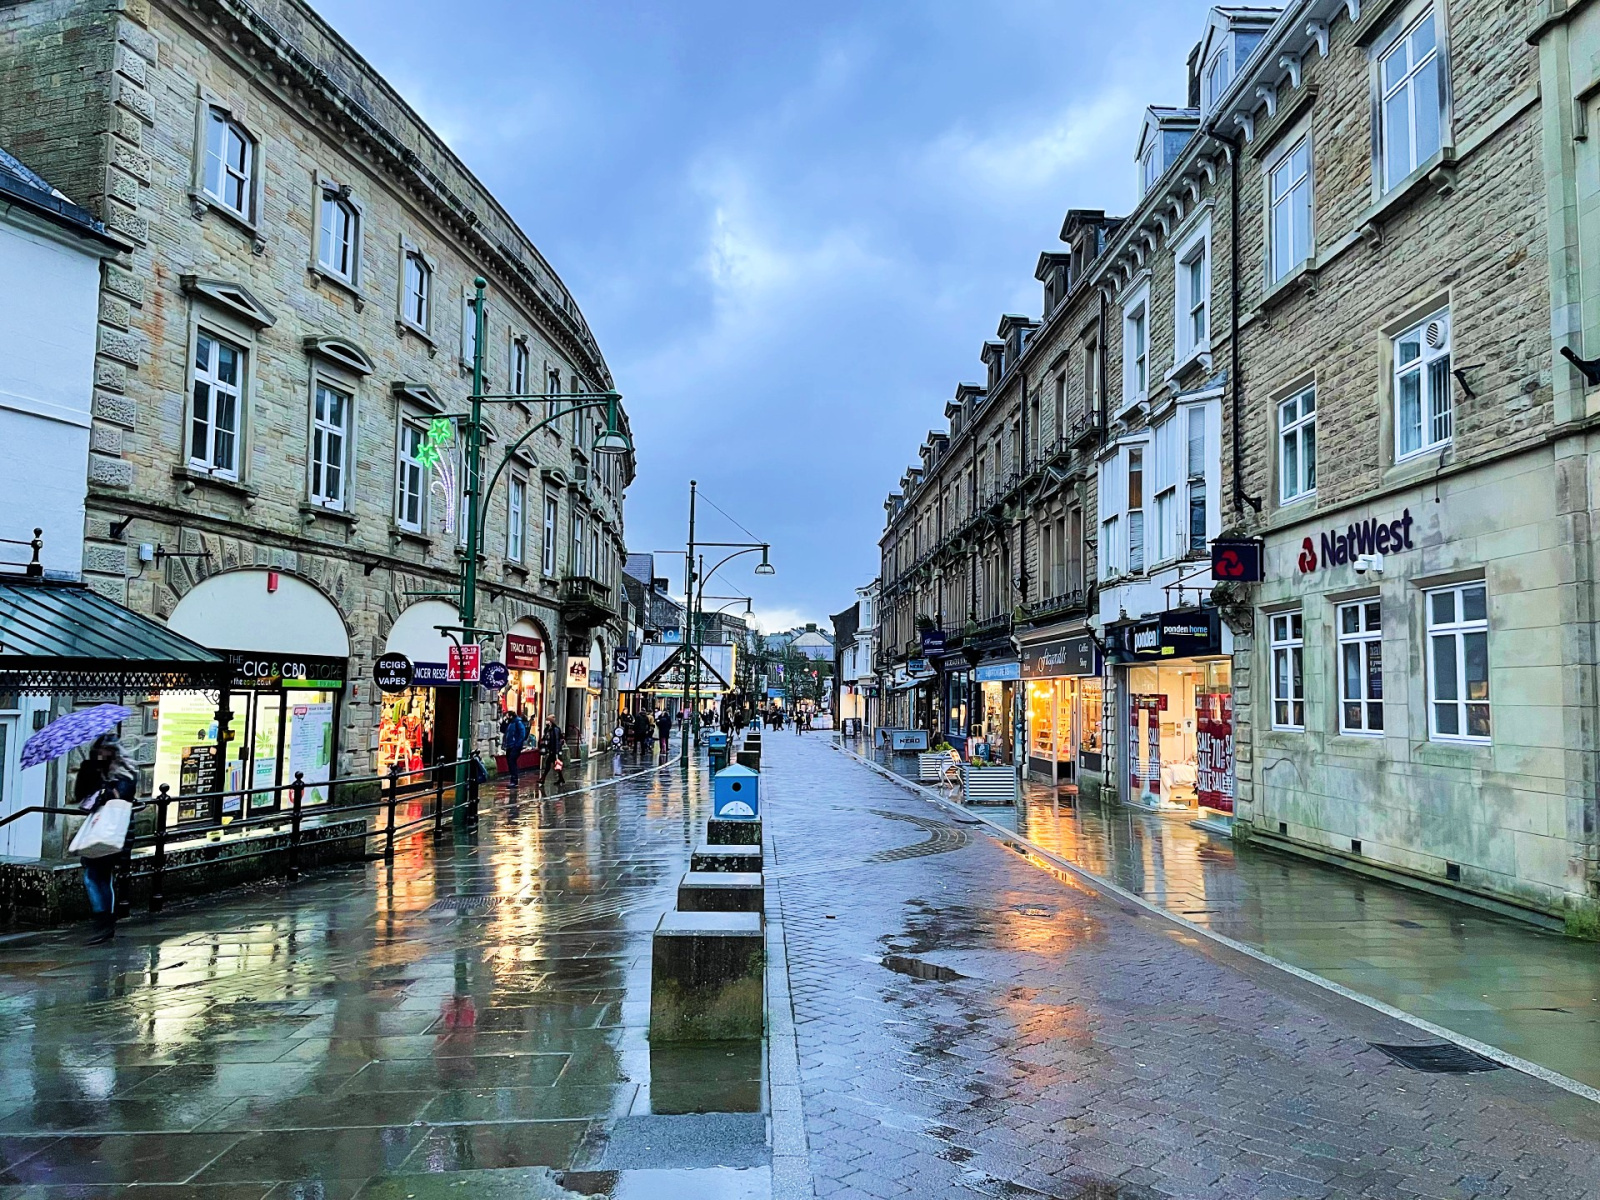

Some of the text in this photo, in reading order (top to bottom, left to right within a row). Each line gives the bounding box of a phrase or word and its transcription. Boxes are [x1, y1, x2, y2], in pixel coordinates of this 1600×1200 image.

[1321, 508, 1413, 568] NatWest
[1164, 625, 1208, 634] ponden home
[1134, 628, 1156, 653] ponden
[510, 642, 538, 655] TRACK TRAIL
[229, 654, 244, 664] THE
[379, 661, 407, 669] ECIGS
[236, 661, 343, 679] -CIG & CBD STORE
[414, 667, 448, 680] NCER RESEA
[379, 677, 407, 685] VAPES
[1197, 732, 1211, 752] SALE
[1198, 752, 1211, 772] SALE
[1198, 772, 1211, 792] SALE
